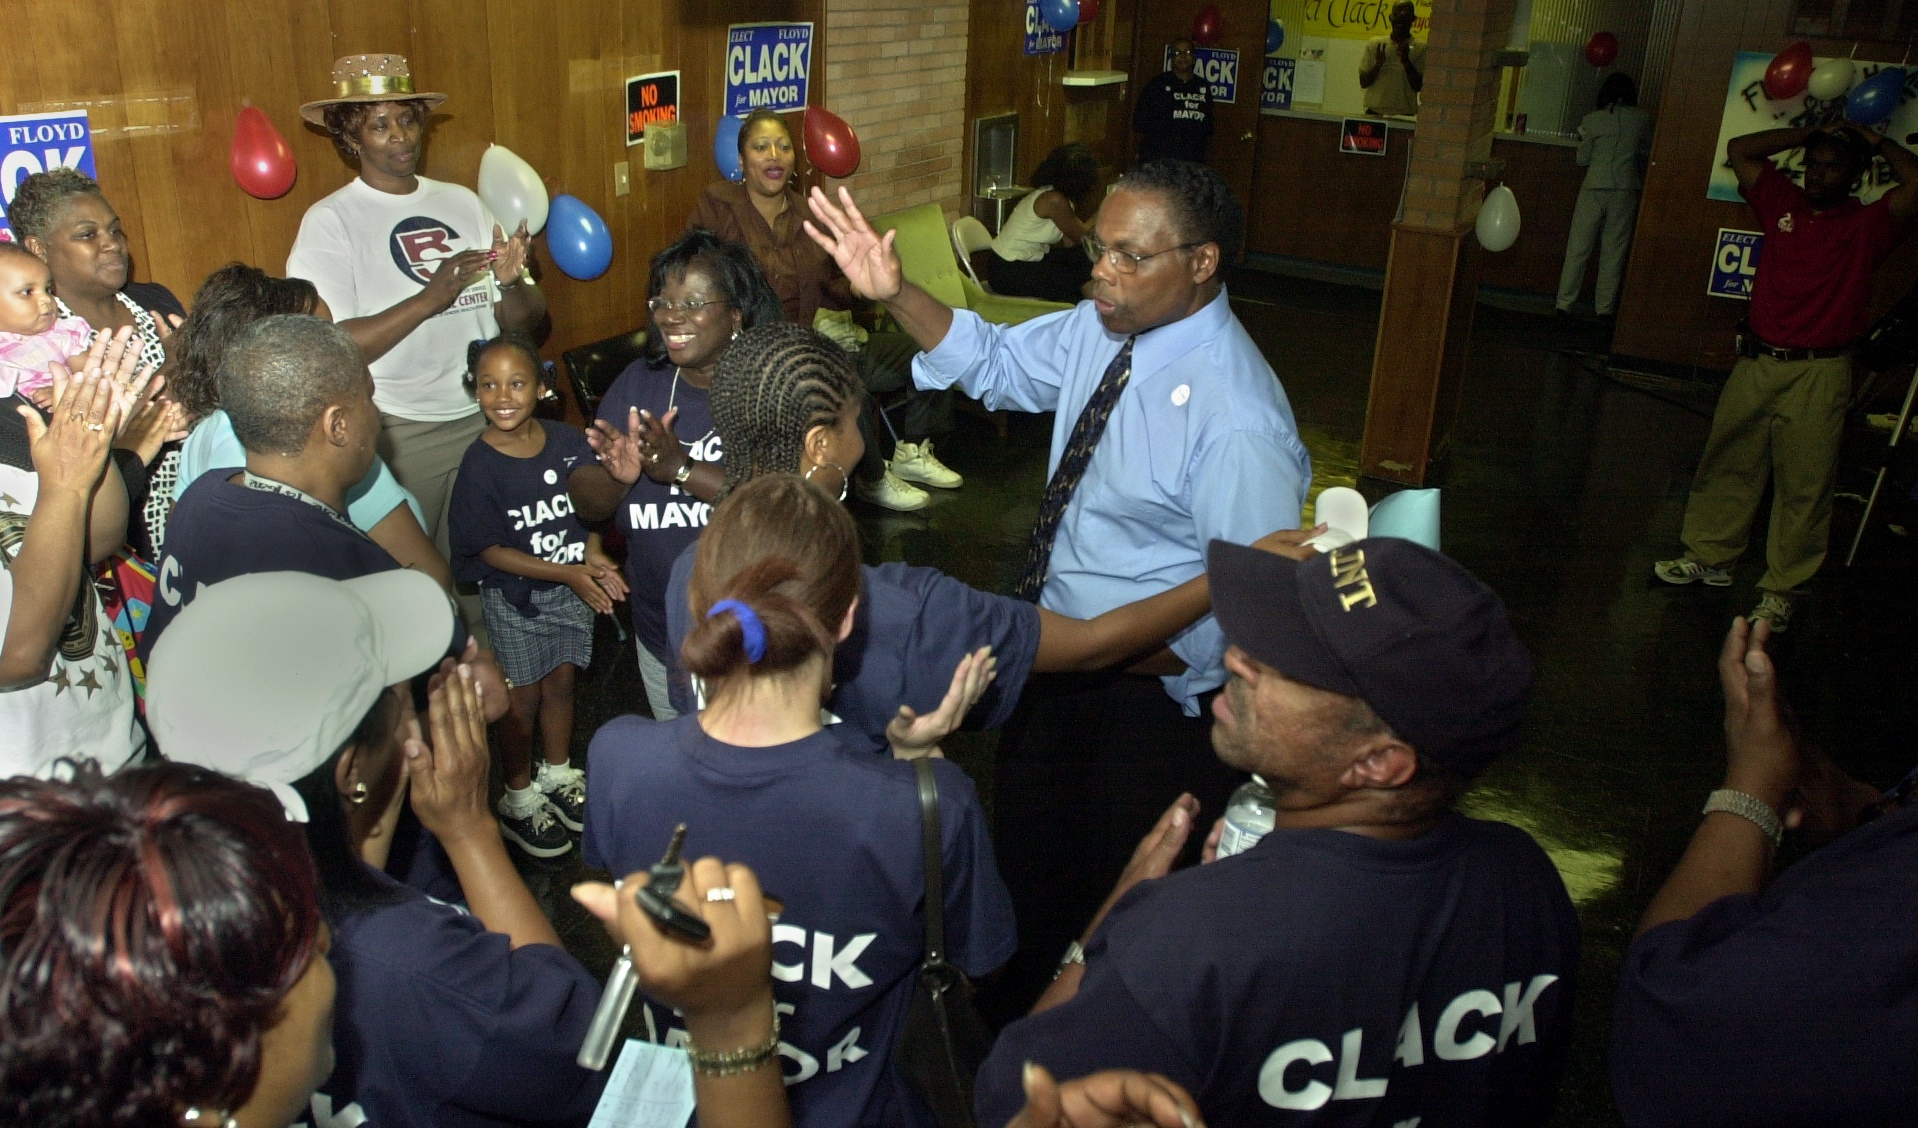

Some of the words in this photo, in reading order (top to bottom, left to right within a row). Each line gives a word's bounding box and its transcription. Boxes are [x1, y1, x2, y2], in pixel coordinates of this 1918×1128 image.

[731, 30, 754, 43] ELECT
[778, 28, 809, 40] FLOYD
[729, 42, 807, 87] CLACK
[641, 83, 658, 108] NO
[734, 93, 747, 108] for
[749, 85, 799, 107] MAYOR
[1173, 91, 1206, 103] CLACK
[629, 104, 676, 135] SMOKING
[9, 122, 85, 145] FLOYD
[1722, 232, 1758, 245] ELECT
[458, 291, 489, 307] CENTER
[1257, 973, 1560, 1112] CLACK
